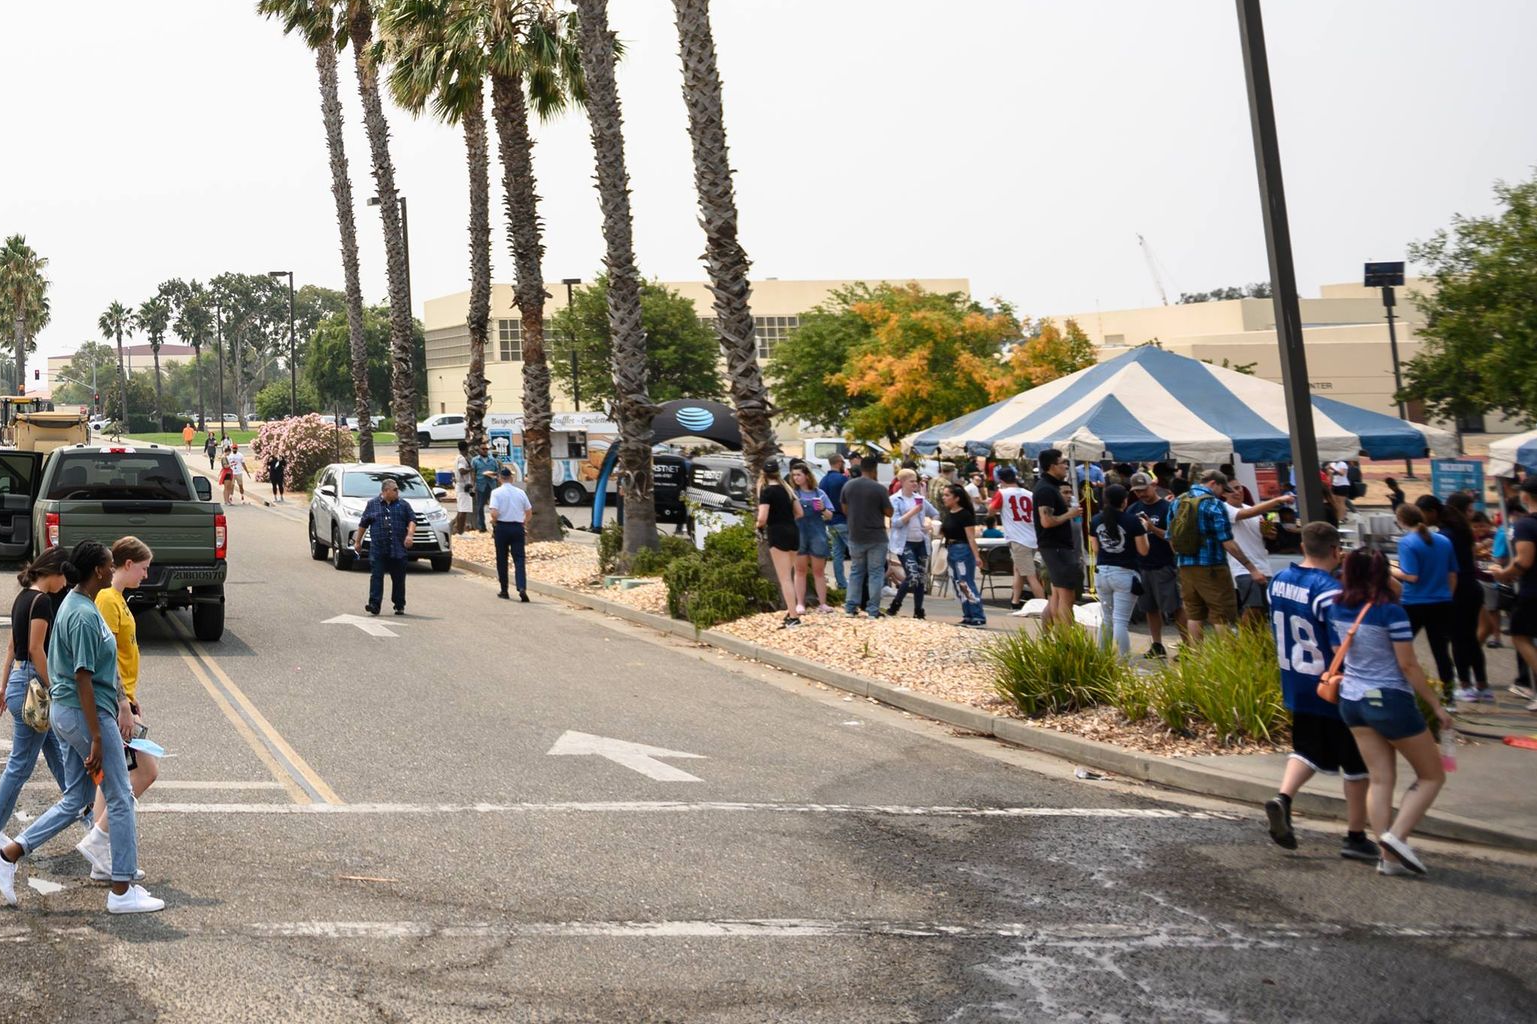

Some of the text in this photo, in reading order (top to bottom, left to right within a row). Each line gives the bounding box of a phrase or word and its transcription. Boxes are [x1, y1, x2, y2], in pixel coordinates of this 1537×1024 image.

[652, 464, 680, 473] RSTNET
[1008, 495, 1034, 523] 19
[1273, 610, 1325, 675] 18
